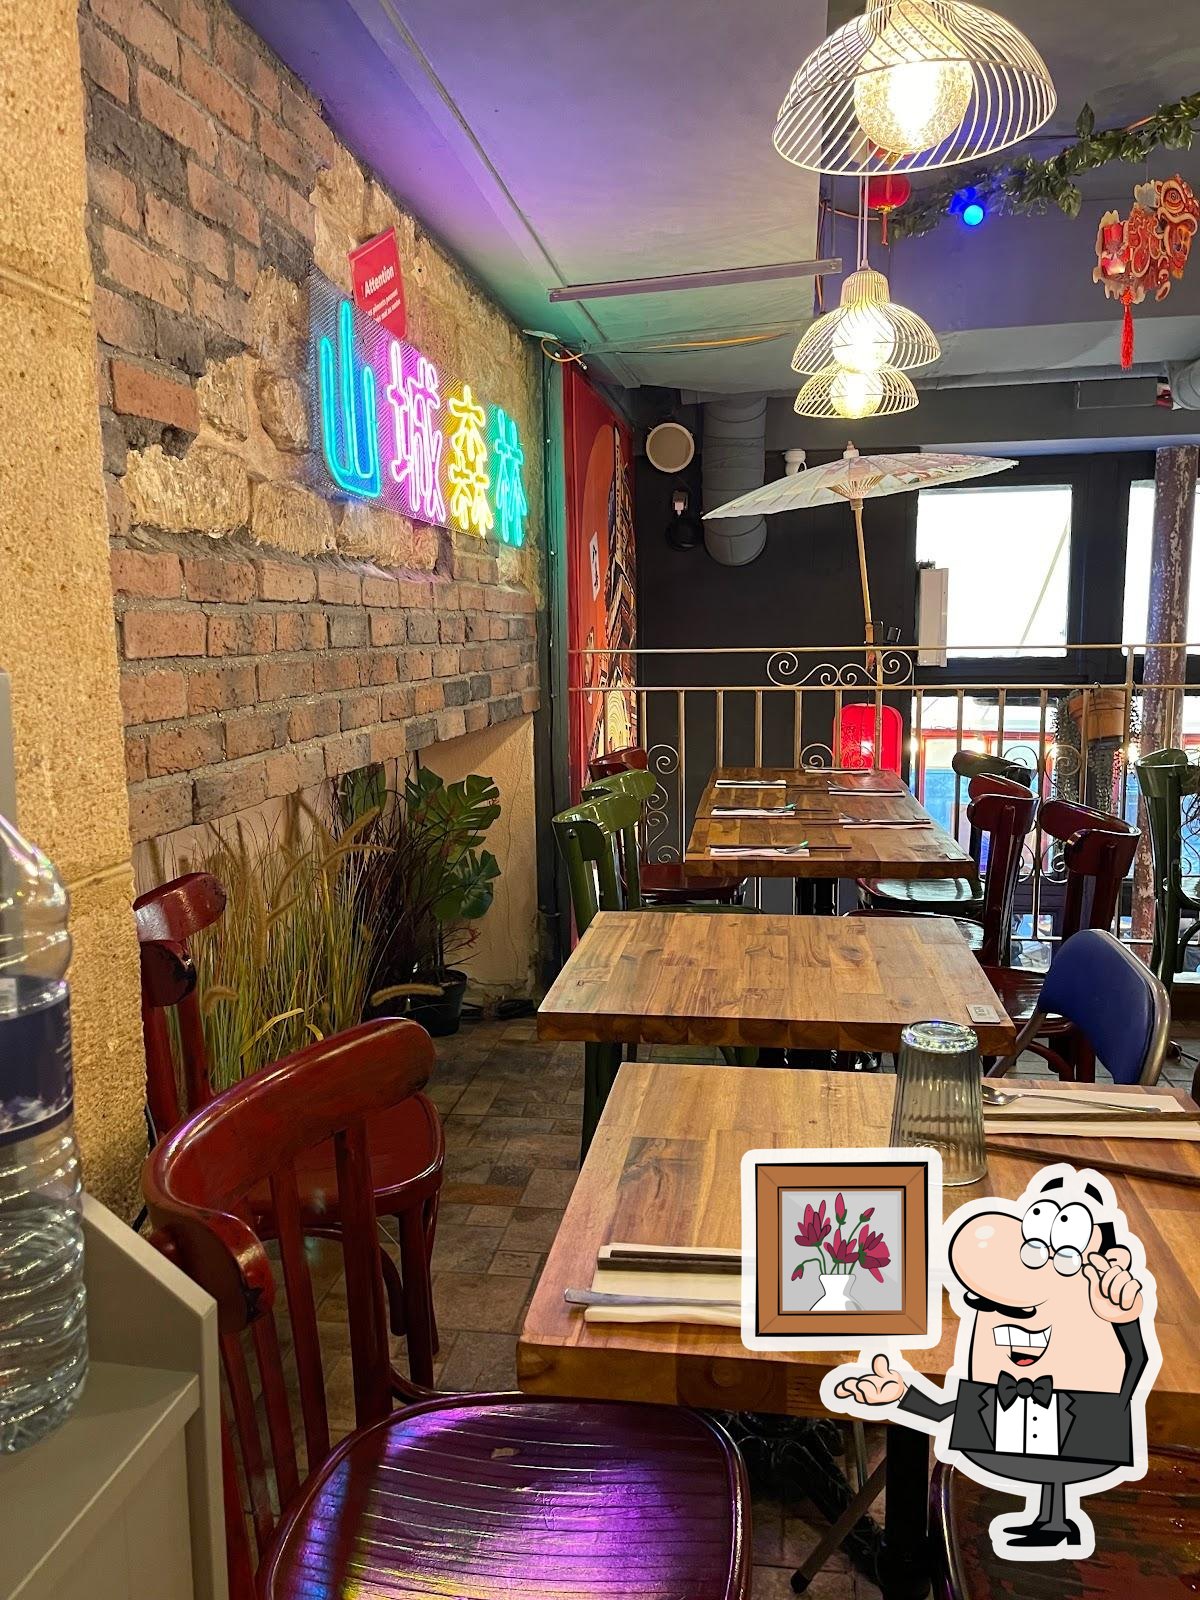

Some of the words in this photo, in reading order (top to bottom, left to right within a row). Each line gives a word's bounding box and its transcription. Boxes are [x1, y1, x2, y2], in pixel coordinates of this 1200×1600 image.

[364, 265, 395, 298] Attention
[319, 299, 528, 547] 山城森林
